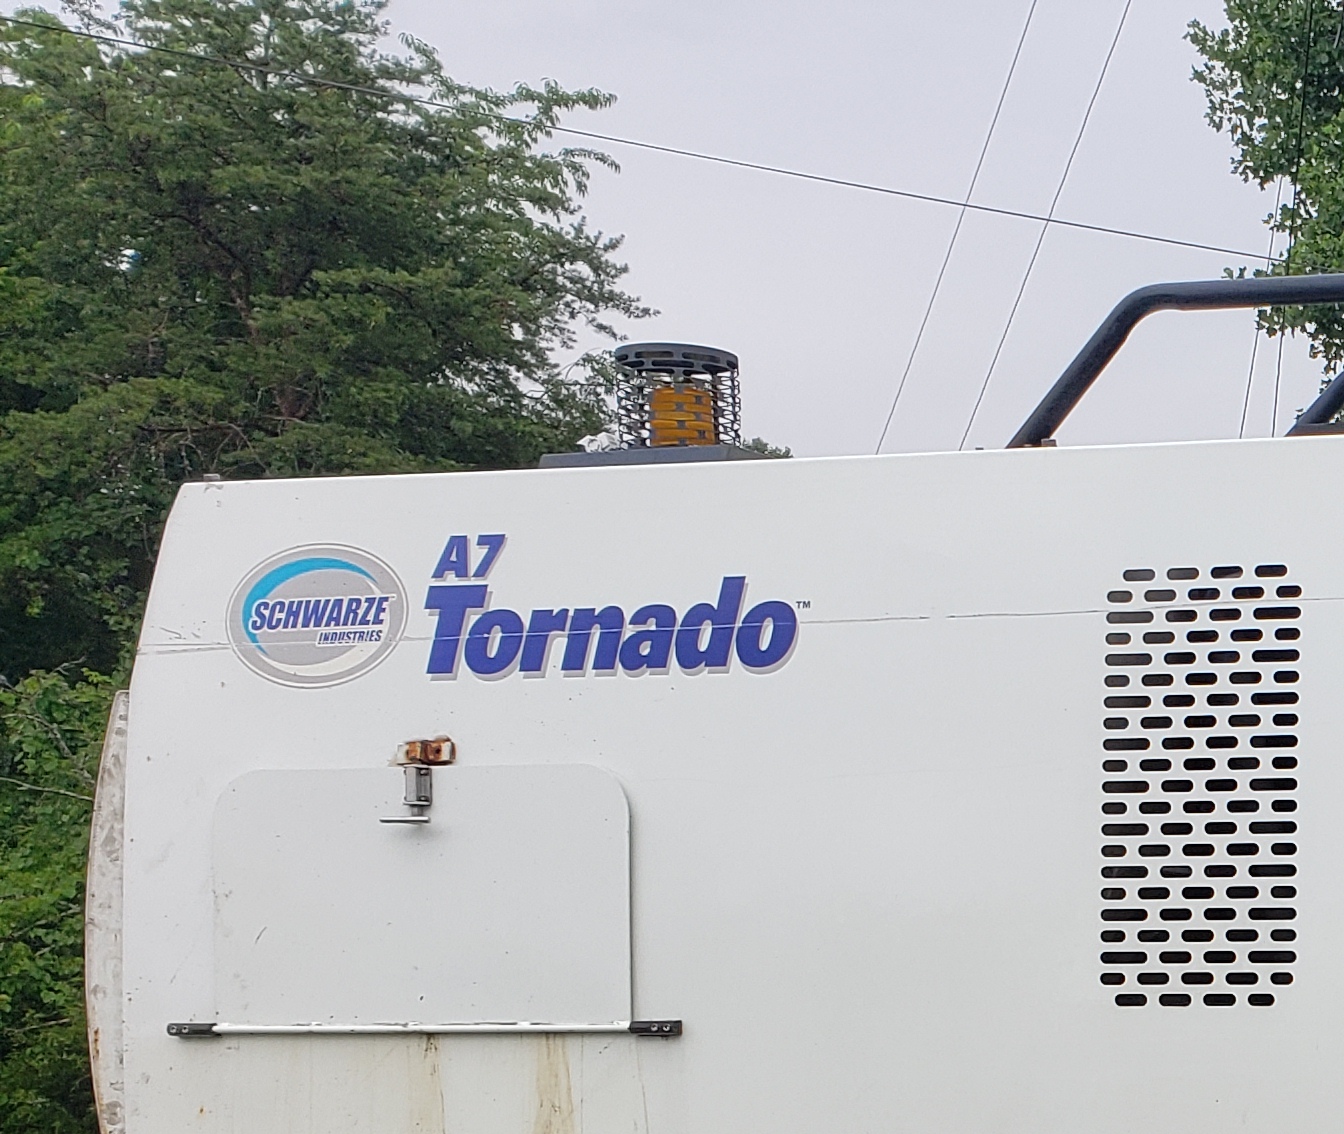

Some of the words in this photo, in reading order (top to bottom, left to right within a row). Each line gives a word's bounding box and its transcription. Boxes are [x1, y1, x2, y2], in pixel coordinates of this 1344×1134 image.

[431, 533, 507, 580] A7
[250, 596, 390, 632] SCHWARZE
[424, 575, 799, 678] Tornado
[316, 629, 383, 646] INDUSTRIES
